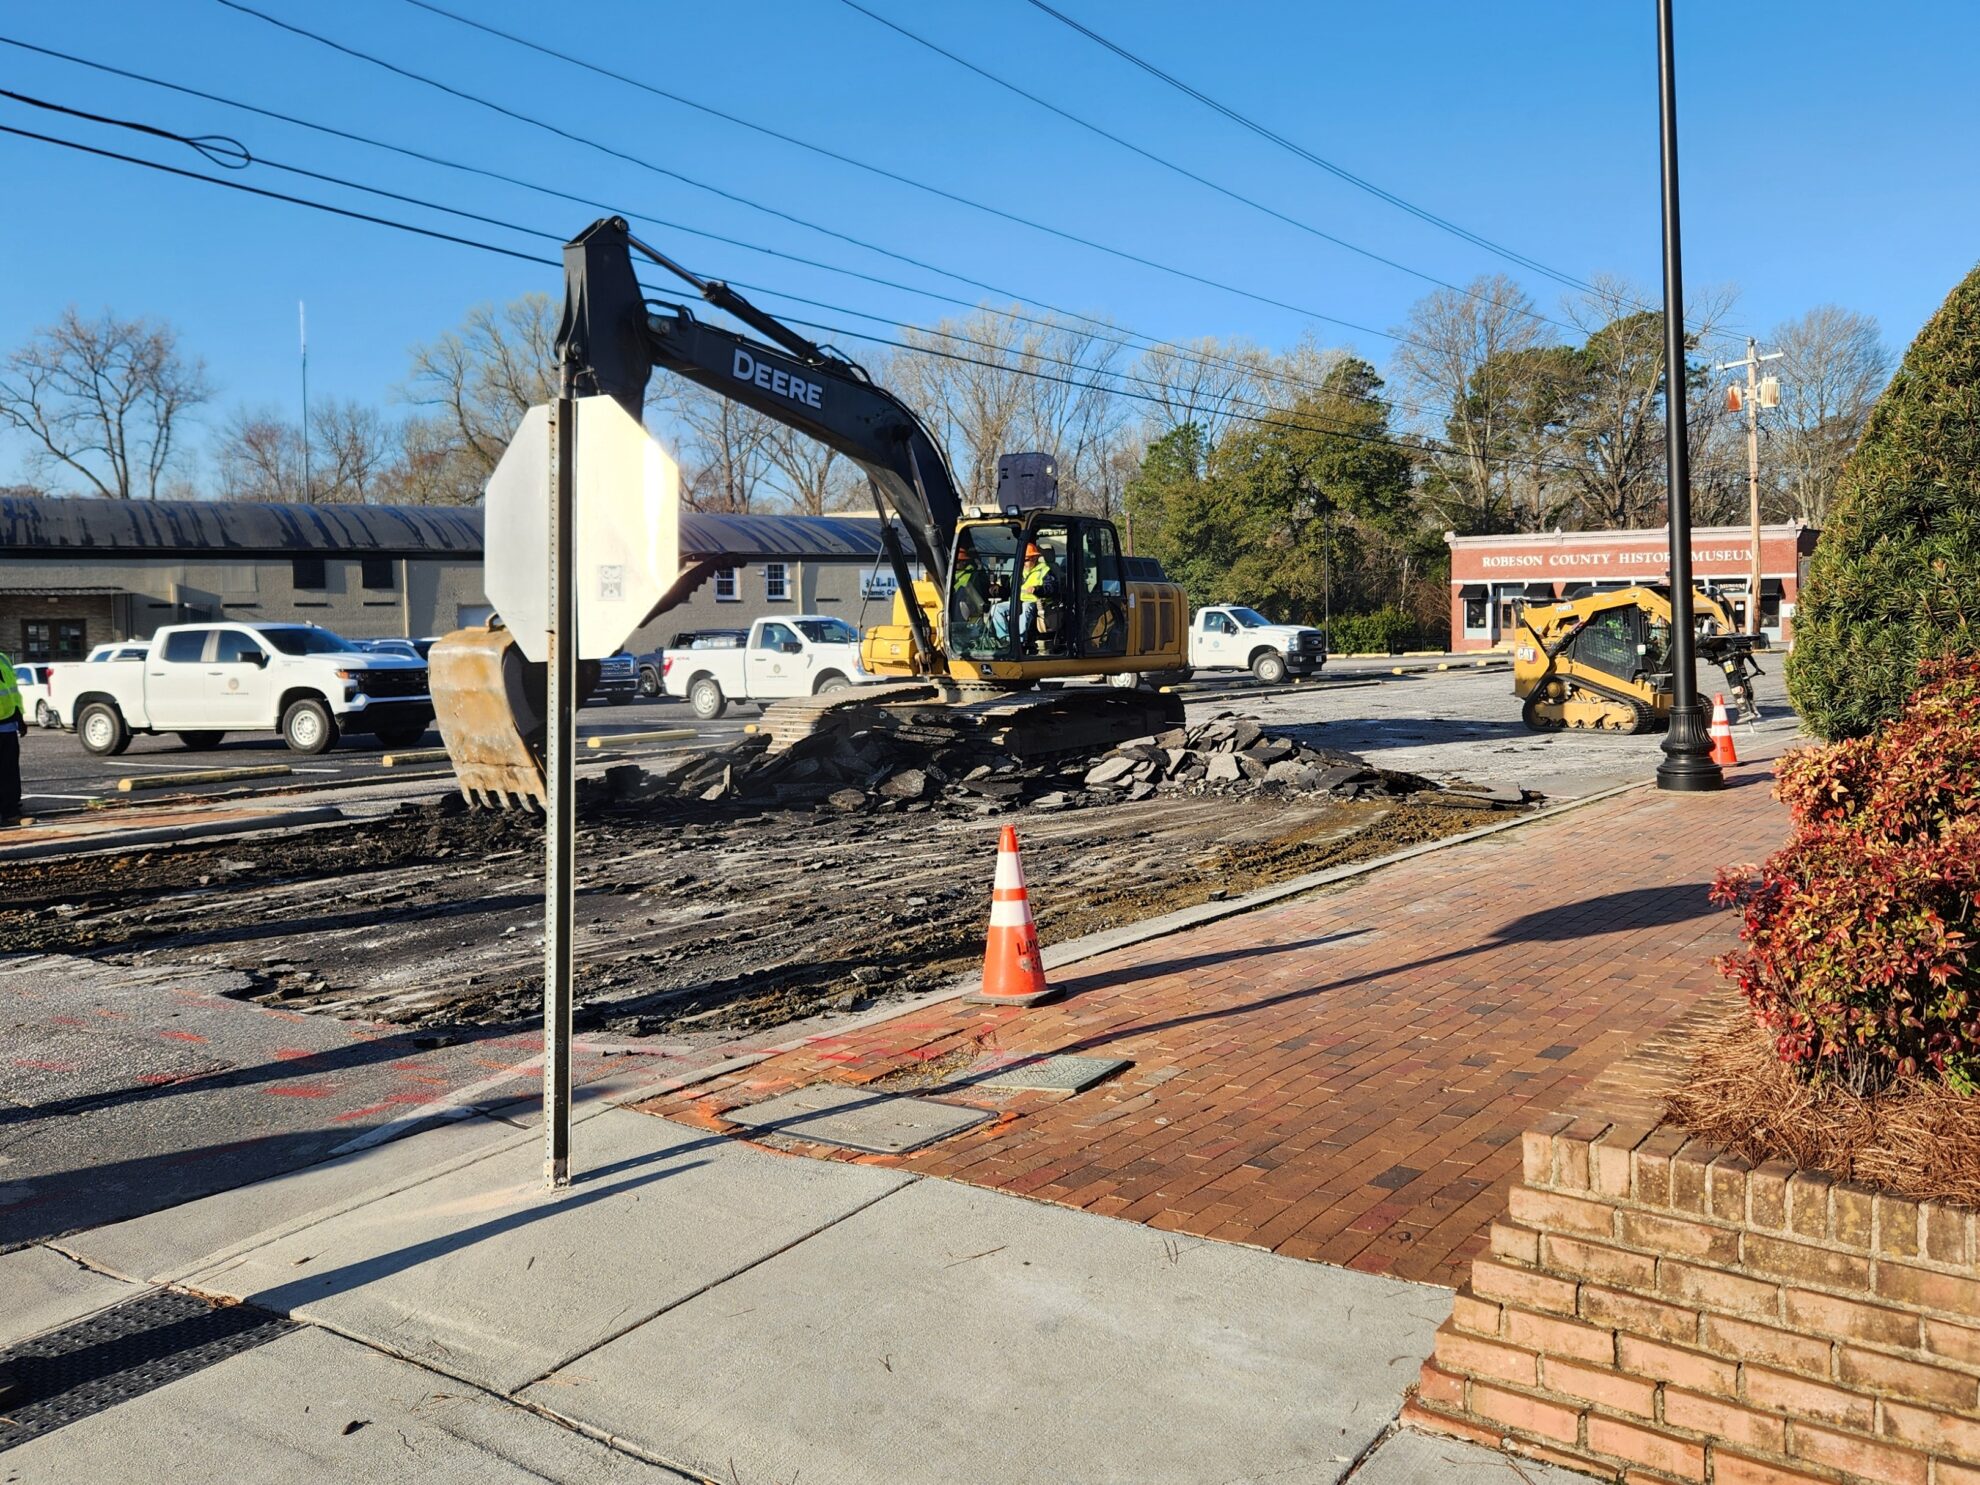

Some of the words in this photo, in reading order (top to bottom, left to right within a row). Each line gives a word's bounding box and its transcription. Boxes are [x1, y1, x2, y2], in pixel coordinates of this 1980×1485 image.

[733, 348, 823, 409] DEERE
[1482, 555, 1543, 568] ROBESON
[1549, 552, 1610, 566] COUNTY
[1619, 551, 1671, 563] HISTOR
